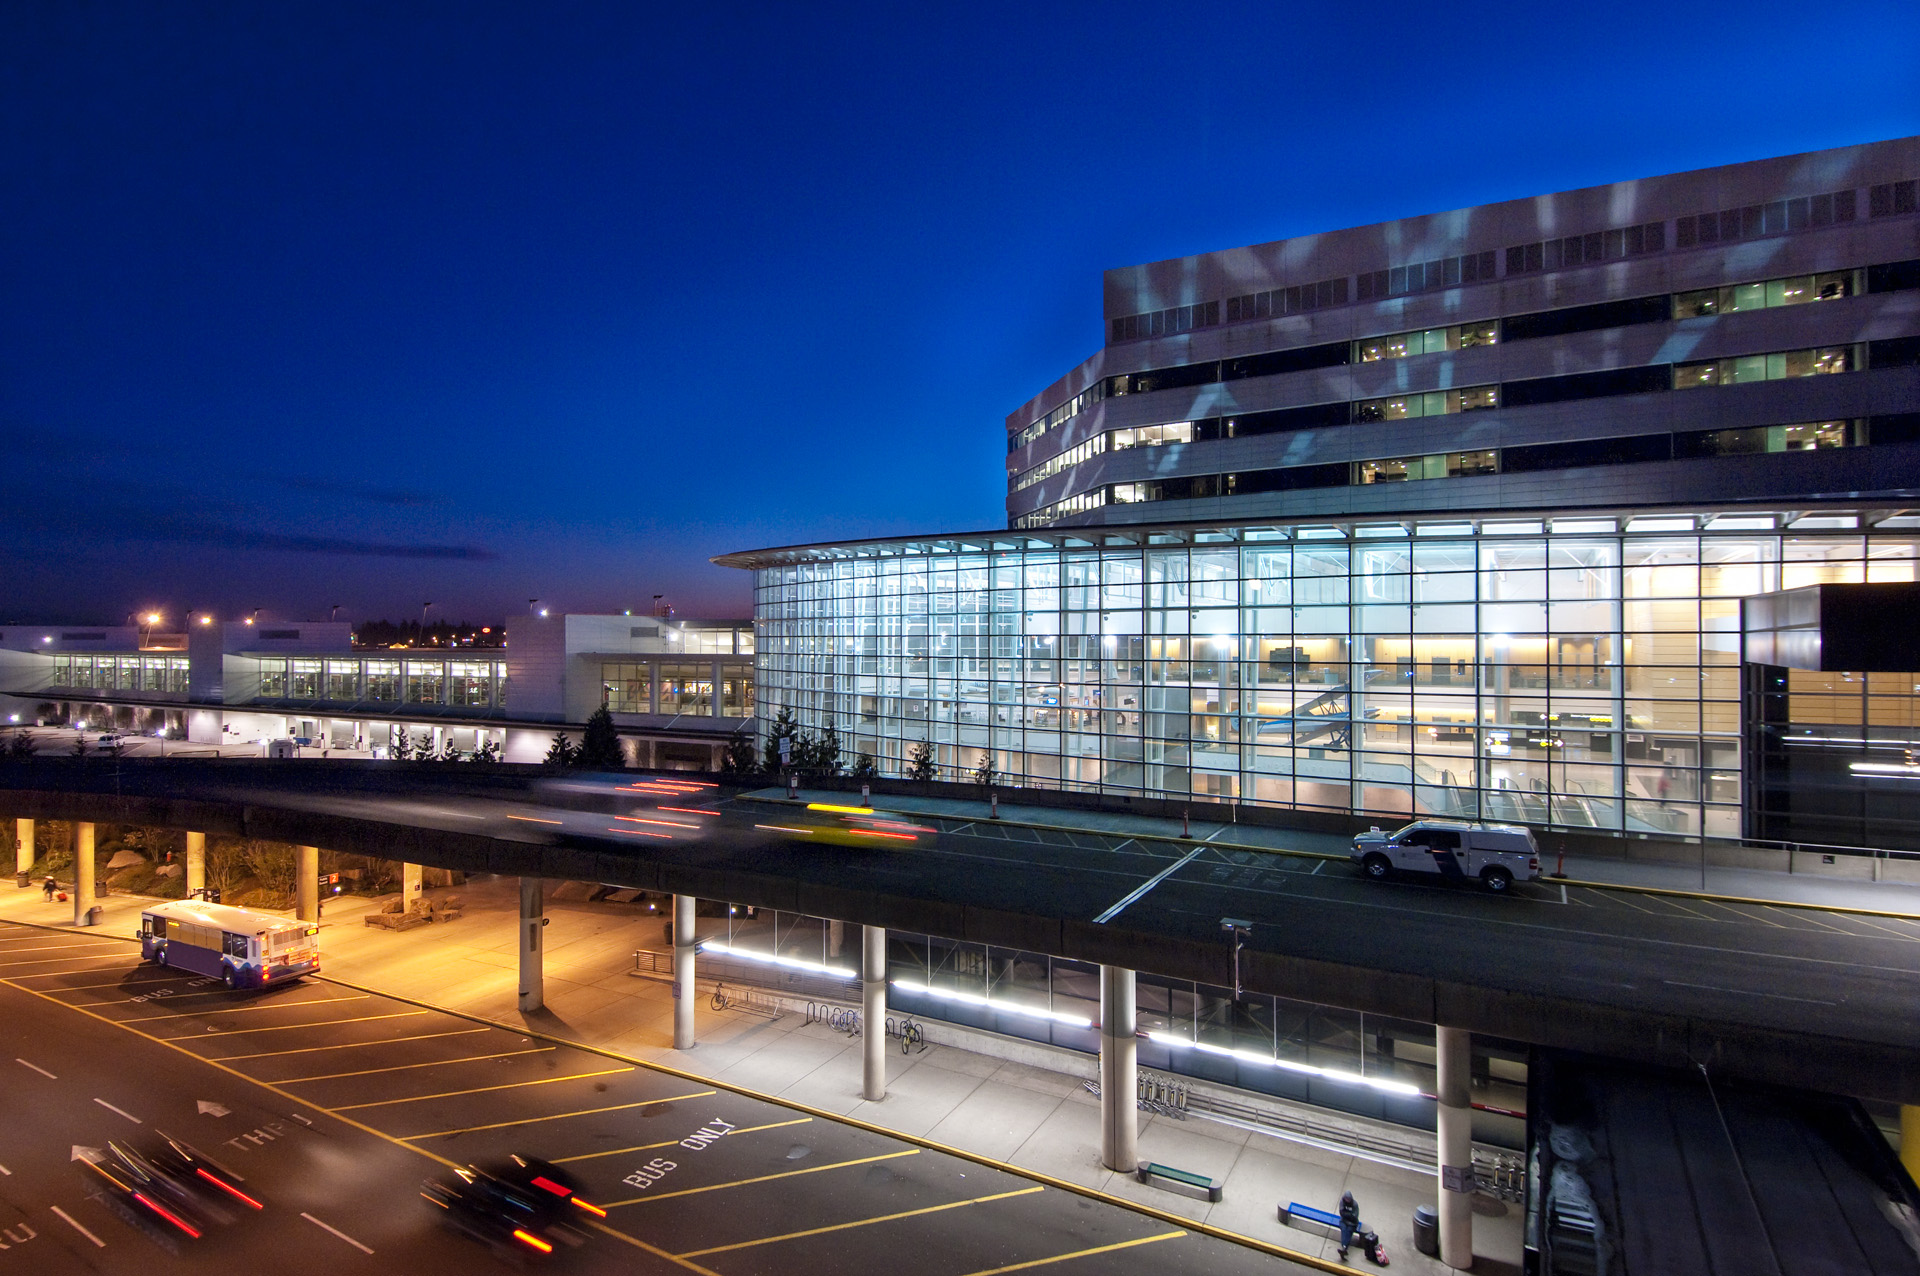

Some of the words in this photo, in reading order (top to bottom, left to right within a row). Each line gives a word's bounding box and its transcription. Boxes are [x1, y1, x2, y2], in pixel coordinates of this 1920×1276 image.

[131, 988, 175, 1003] BUS
[187, 977, 218, 987] ON
[622, 1157, 678, 1190] BUS
[679, 1117, 736, 1151] ONLY
